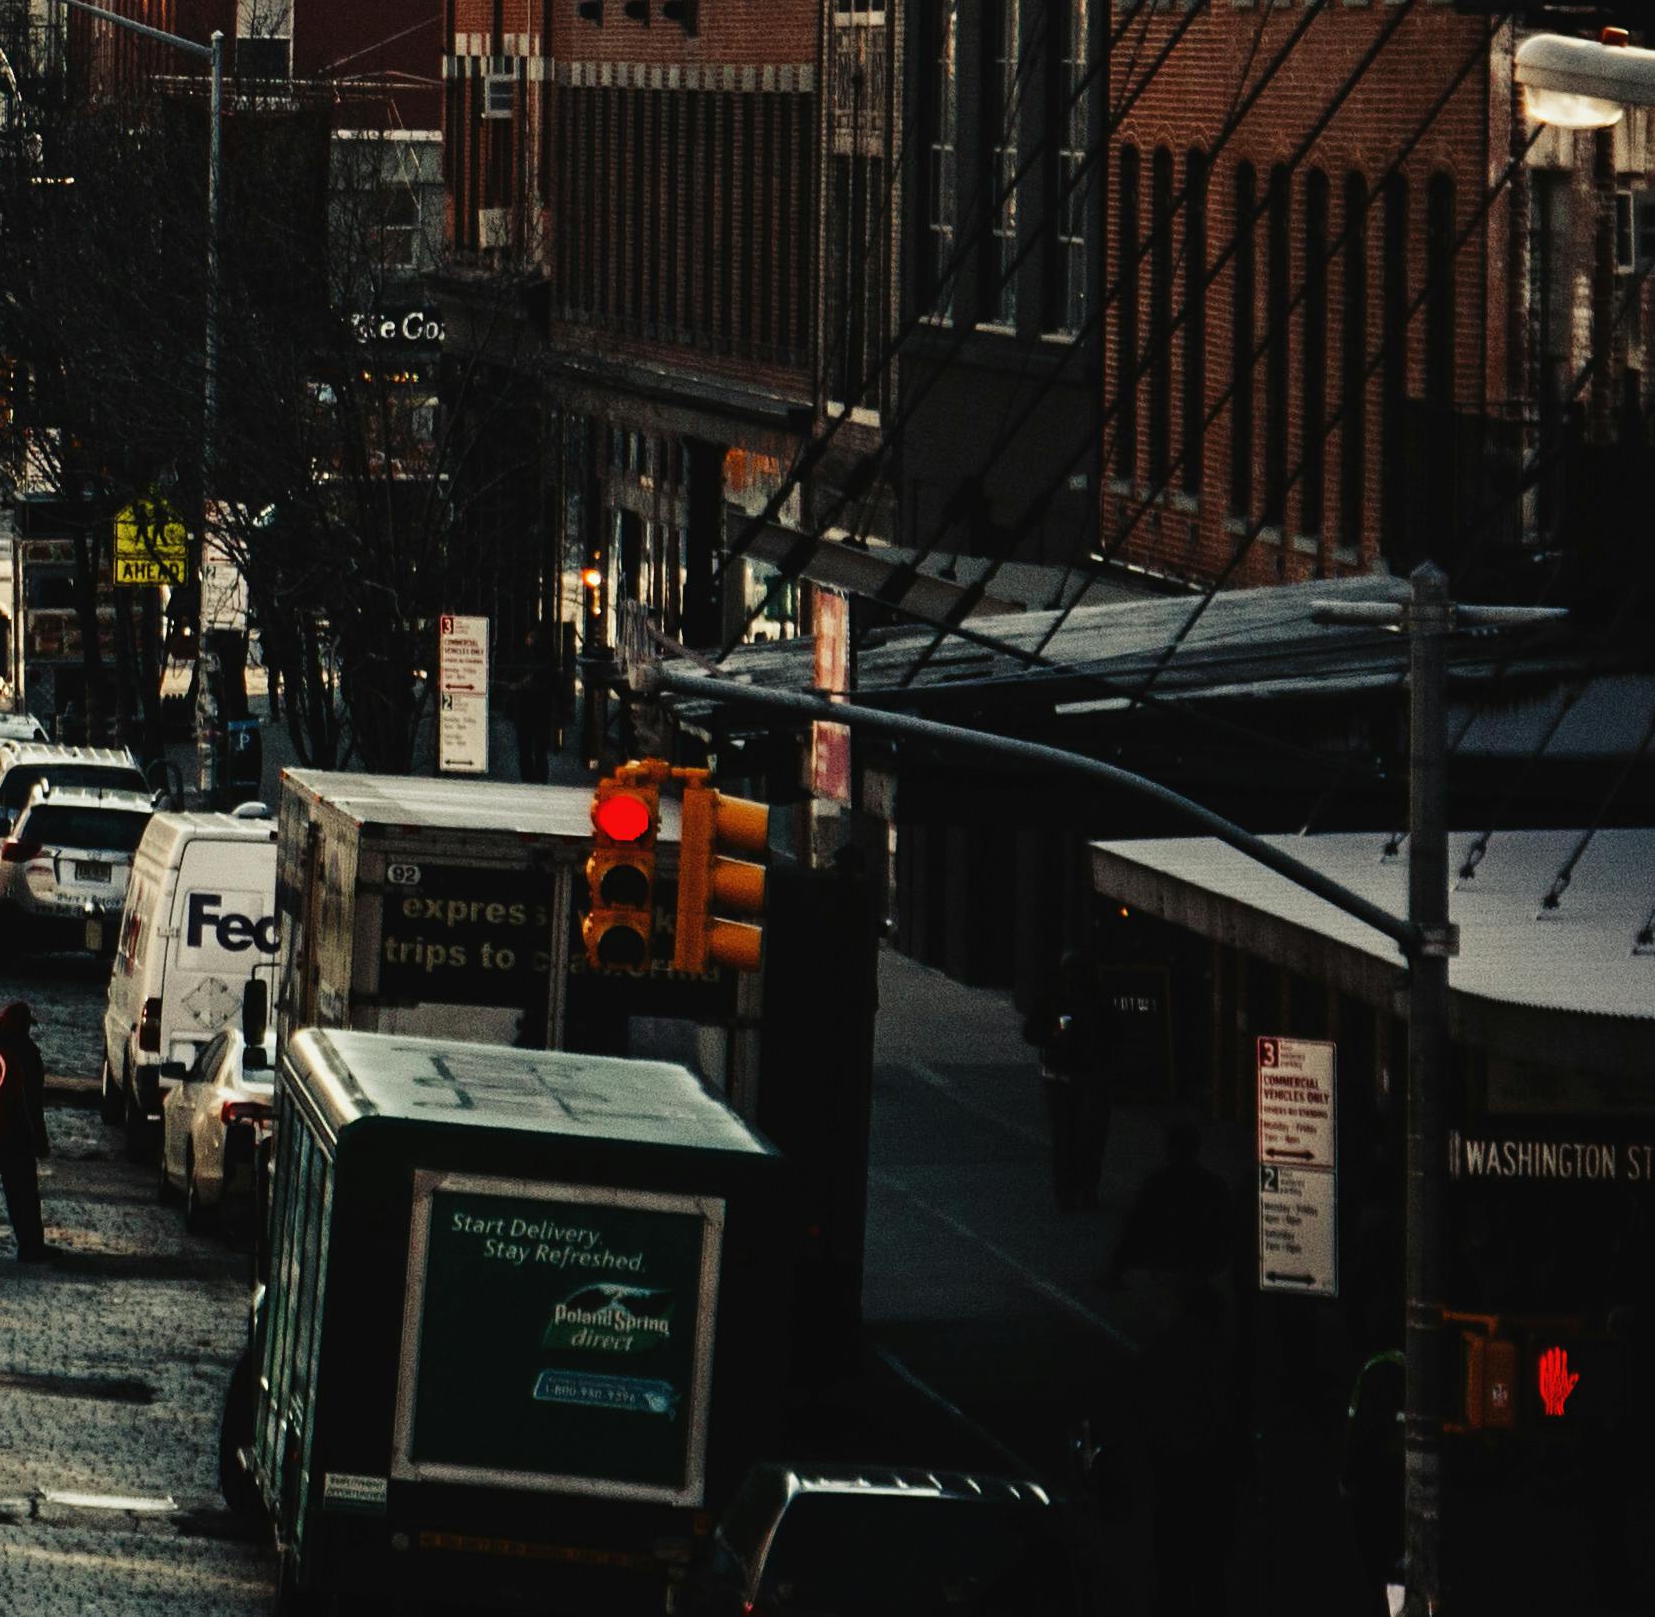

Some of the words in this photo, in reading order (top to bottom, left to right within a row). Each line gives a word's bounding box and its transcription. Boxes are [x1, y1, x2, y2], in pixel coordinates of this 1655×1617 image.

[122, 562, 180, 580] AHEAD
[443, 618, 452, 634] 3
[391, 866, 416, 882] 92
[402, 896, 547, 928] express
[384, 936, 468, 973] trips
[479, 941, 515, 970] to
[1263, 1041, 1275, 1066] 3
[1264, 1075, 1319, 1089] COMMERCIAL
[1264, 1089, 1305, 1102] VEHICLES
[1307, 1092, 1330, 1104] ONLY
[1466, 1140, 1616, 1180] WASHINGTON
[1627, 1144, 1655, 1181] ST
[1263, 1167, 1276, 1192] 2
[451, 1212, 505, 1237] Start
[509, 1217, 605, 1250] Delivery.
[482, 1237, 532, 1267] Stay
[533, 1242, 647, 1273] Refreshed.
[570, 1327, 634, 1352] direct
